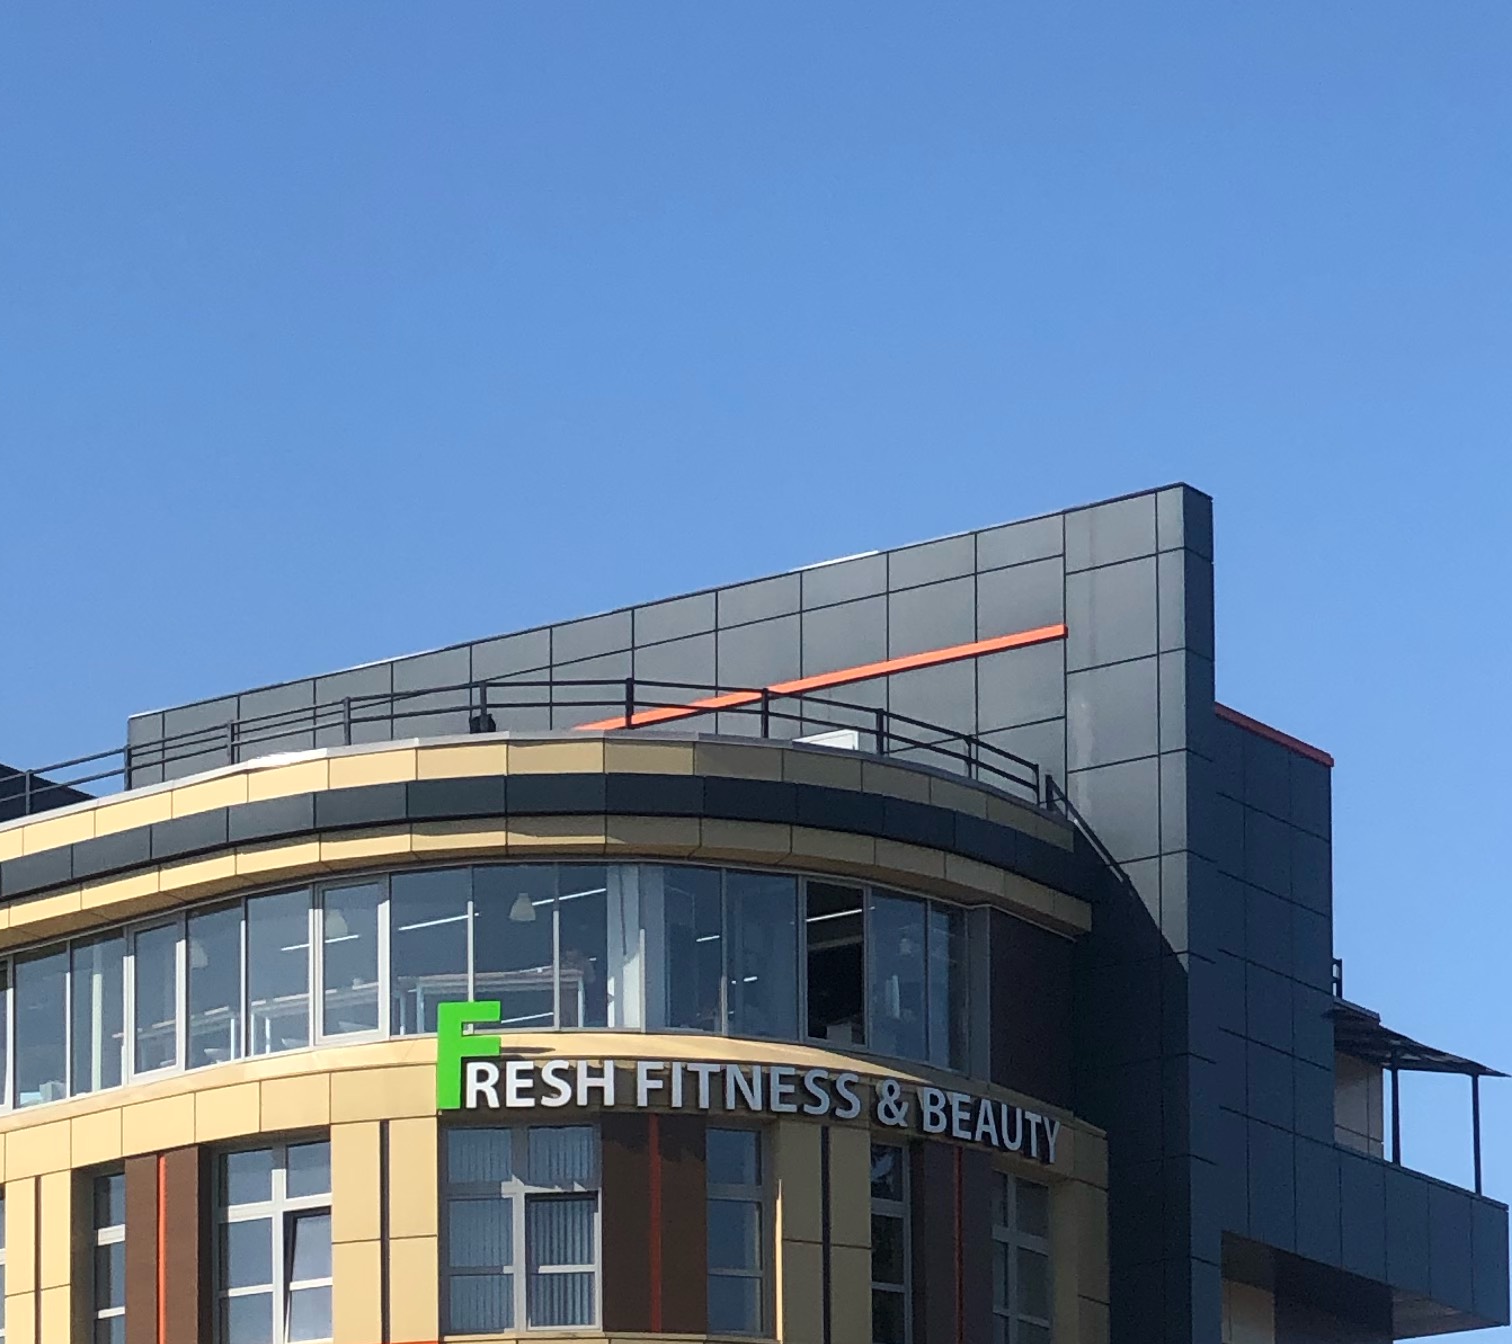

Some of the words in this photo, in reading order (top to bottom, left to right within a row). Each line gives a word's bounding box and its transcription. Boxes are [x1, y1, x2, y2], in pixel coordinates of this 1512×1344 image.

[438, 1001, 615, 1110] FRESH
[637, 1060, 862, 1119] FITNESS
[876, 1079, 909, 1128] &
[920, 1086, 1061, 1165] BEAUTY
